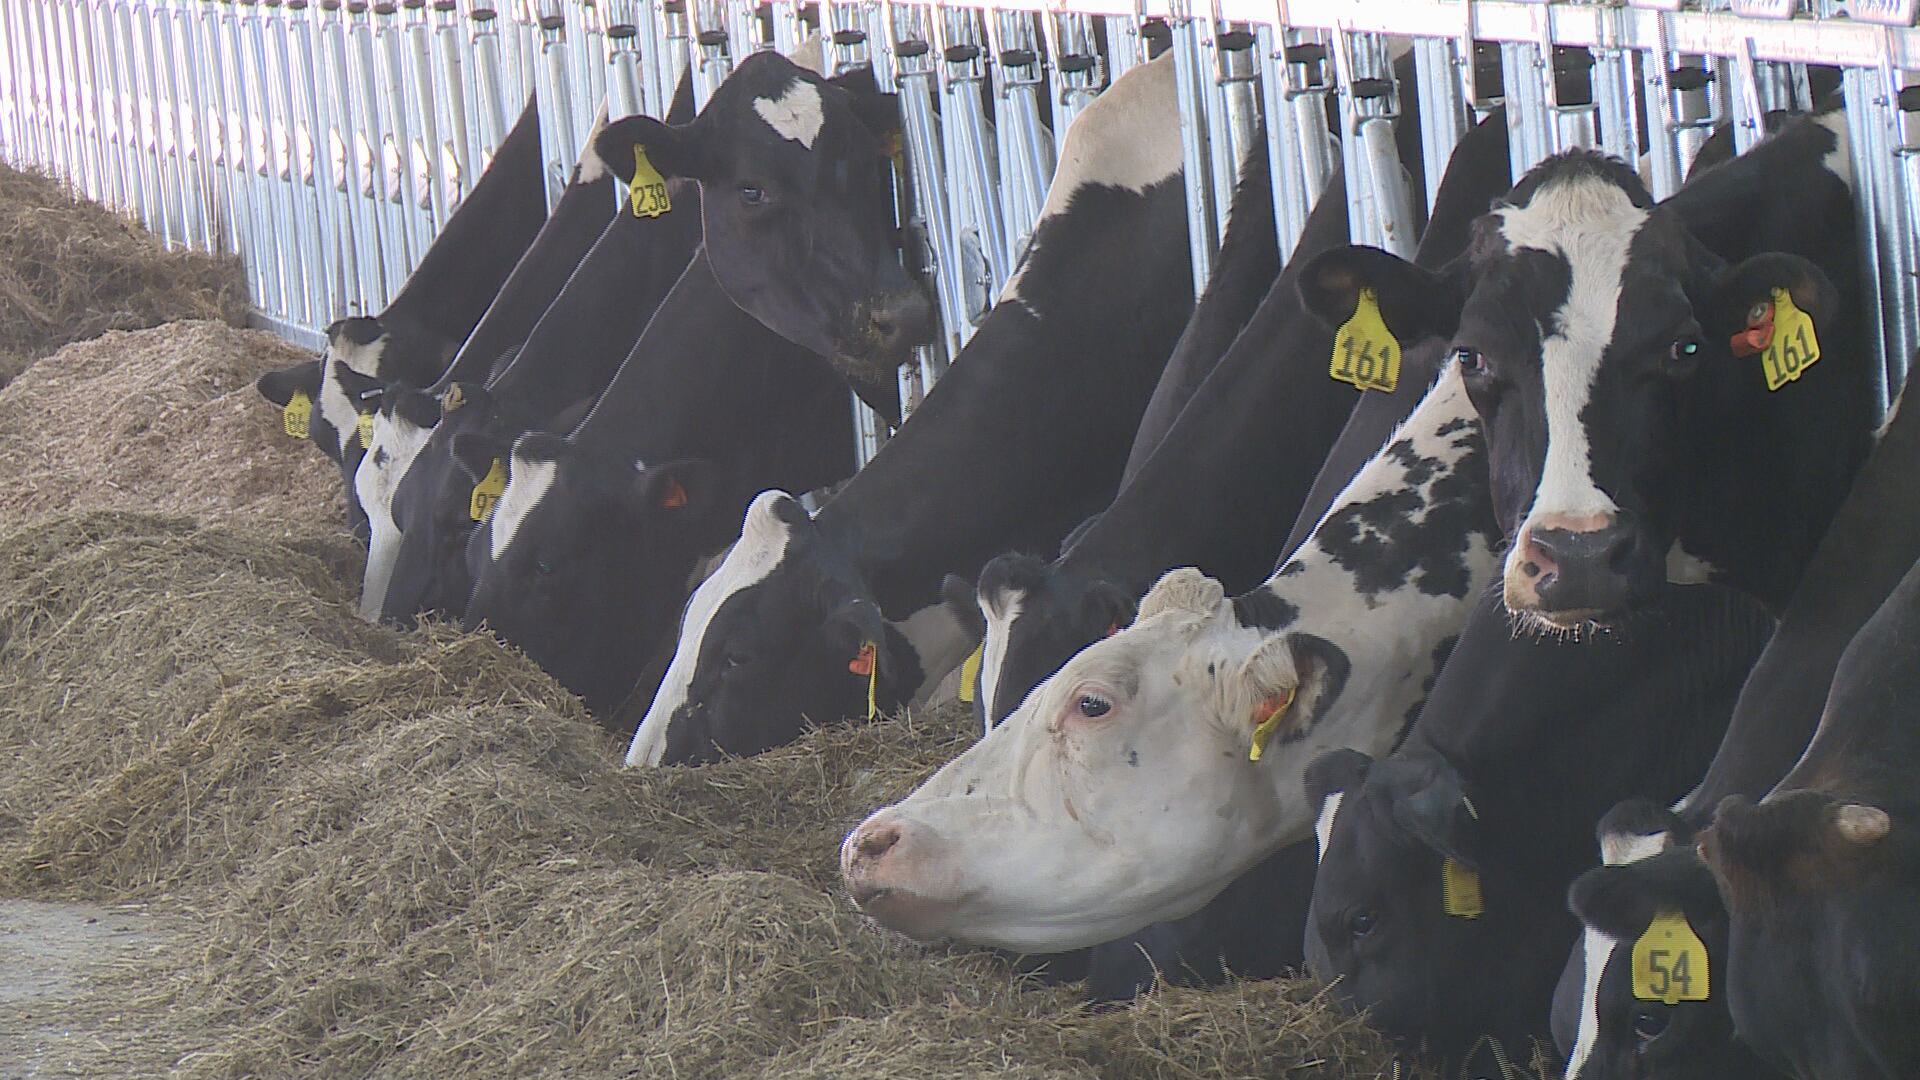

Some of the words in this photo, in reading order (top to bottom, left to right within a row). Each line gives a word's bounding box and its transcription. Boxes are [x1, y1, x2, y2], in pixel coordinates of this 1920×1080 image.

[634, 183, 668, 213] 238
[1336, 336, 1395, 388] 161
[1768, 324, 1815, 385] 161
[1649, 949, 1692, 995] 54
